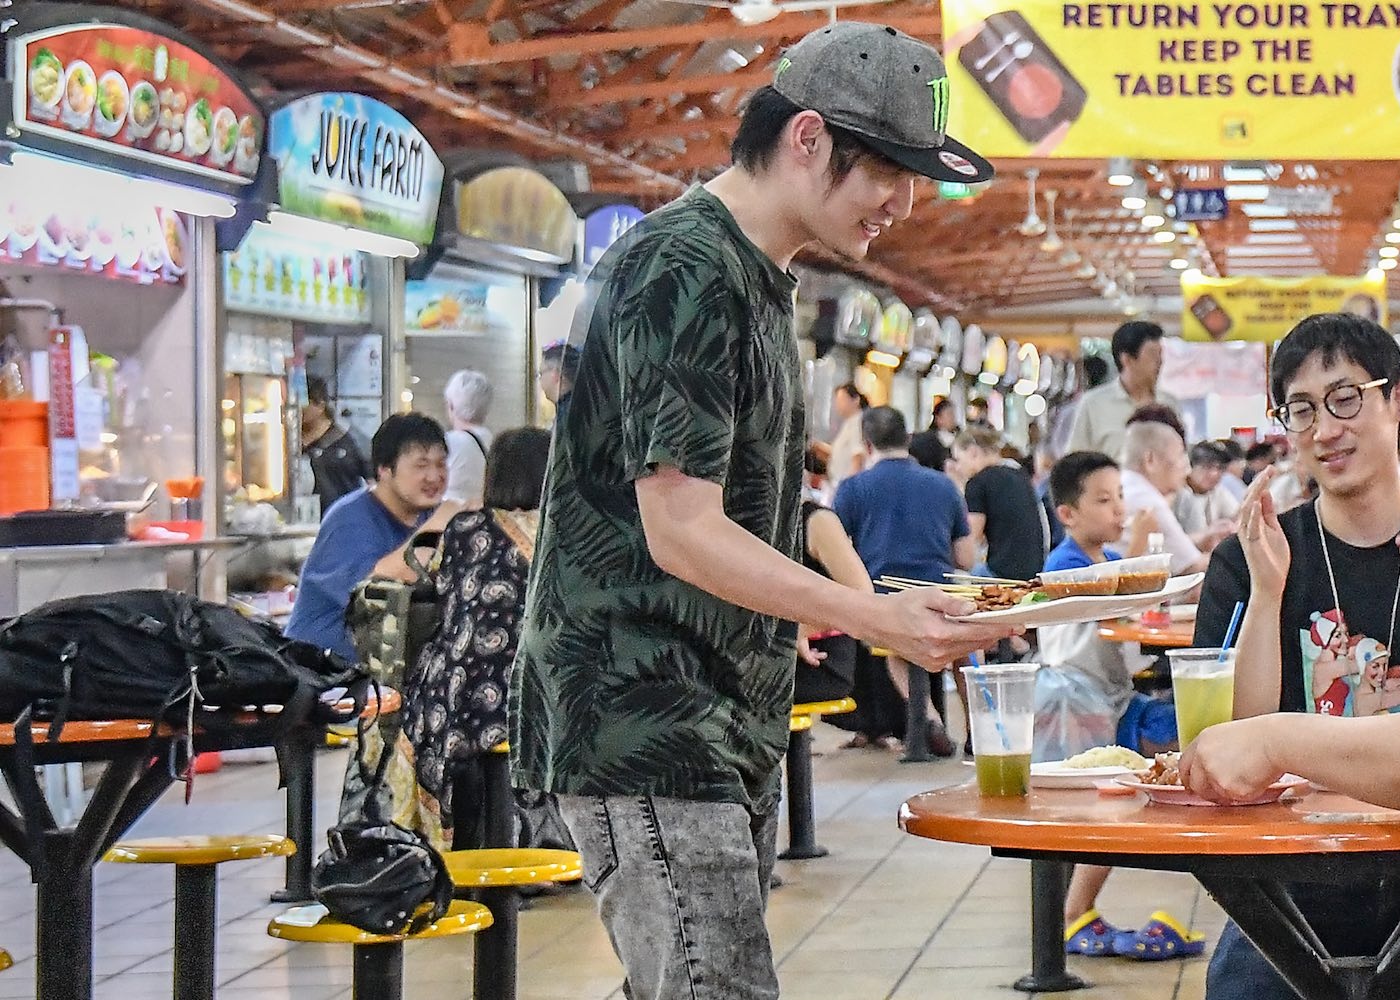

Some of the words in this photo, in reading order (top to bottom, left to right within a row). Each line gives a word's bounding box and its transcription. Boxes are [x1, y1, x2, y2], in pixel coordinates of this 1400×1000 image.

[1063, 4, 1199, 28] RETURN
[1212, 4, 1309, 28] YOUR
[1160, 40, 1240, 62] KEEP
[1252, 40, 1312, 62] THE
[1114, 74, 1234, 96] TABLES
[1246, 74, 1354, 96] CLEAN
[312, 110, 369, 188] JUICE
[372, 121, 425, 202] FARM
